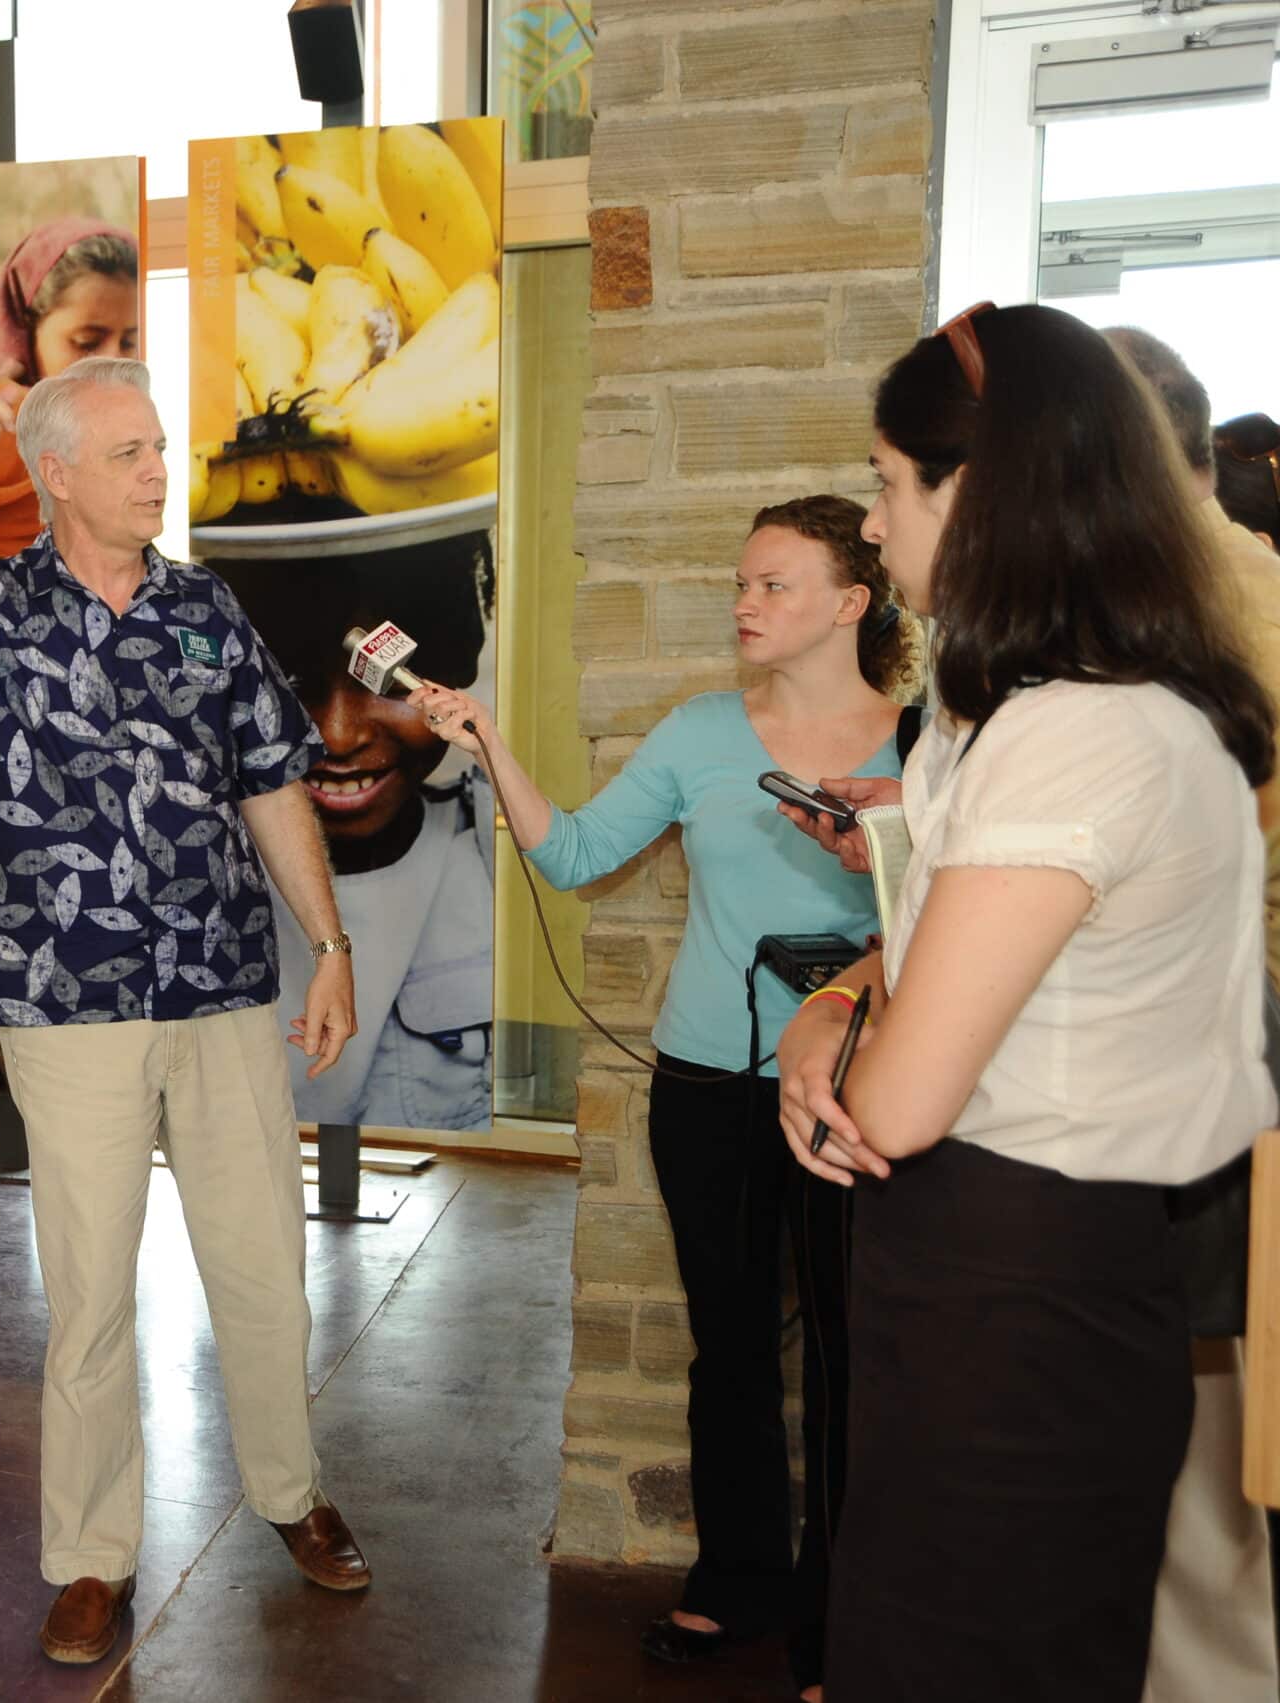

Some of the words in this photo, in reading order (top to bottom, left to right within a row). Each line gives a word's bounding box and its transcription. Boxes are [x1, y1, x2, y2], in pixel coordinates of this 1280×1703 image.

[203, 157, 221, 247] MARKETS
[203, 257, 219, 297] FAIR
[376, 635, 410, 662] KUAR
